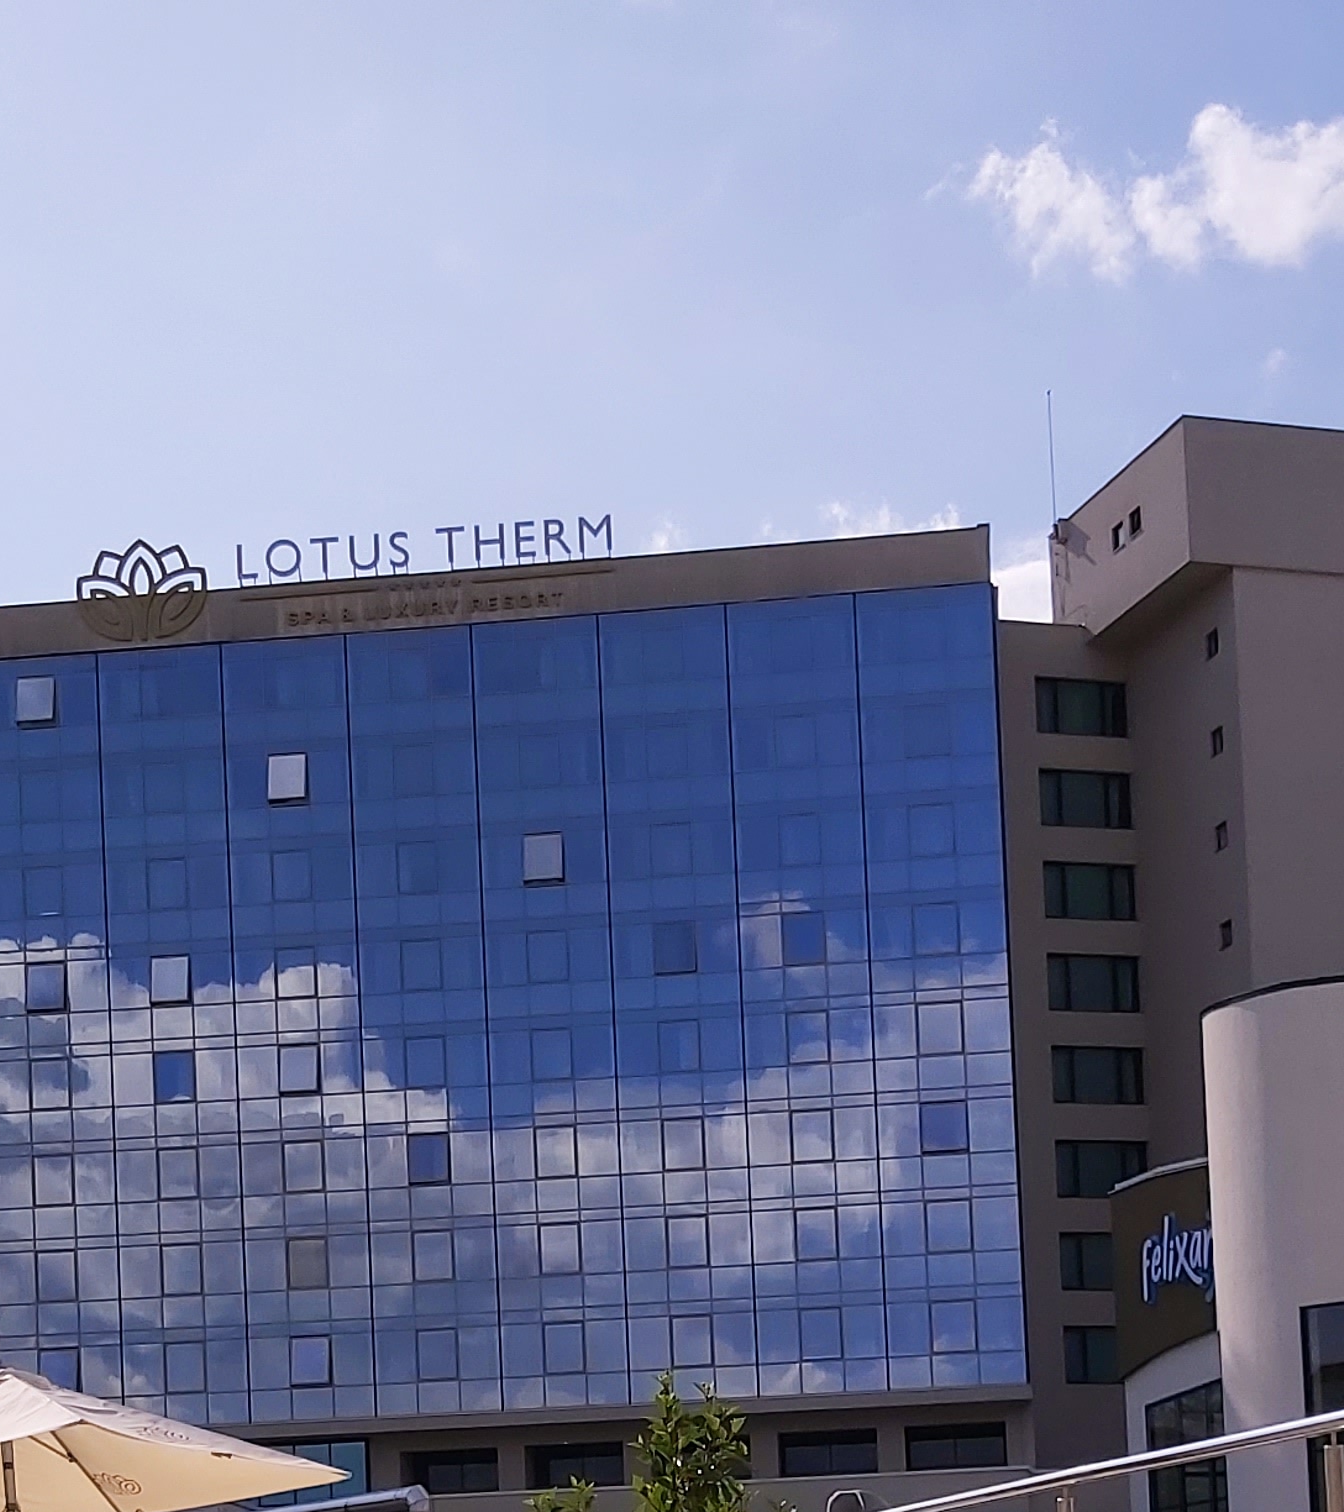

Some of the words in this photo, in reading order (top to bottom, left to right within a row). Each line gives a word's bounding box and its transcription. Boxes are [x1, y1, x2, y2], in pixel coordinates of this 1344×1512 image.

[236, 531, 409, 580] LOTUS
[435, 514, 612, 563] THERM
[287, 611, 332, 628] SPA
[342, 608, 355, 623] &
[364, 599, 460, 622] LUXURY
[472, 592, 564, 613] RESORT
